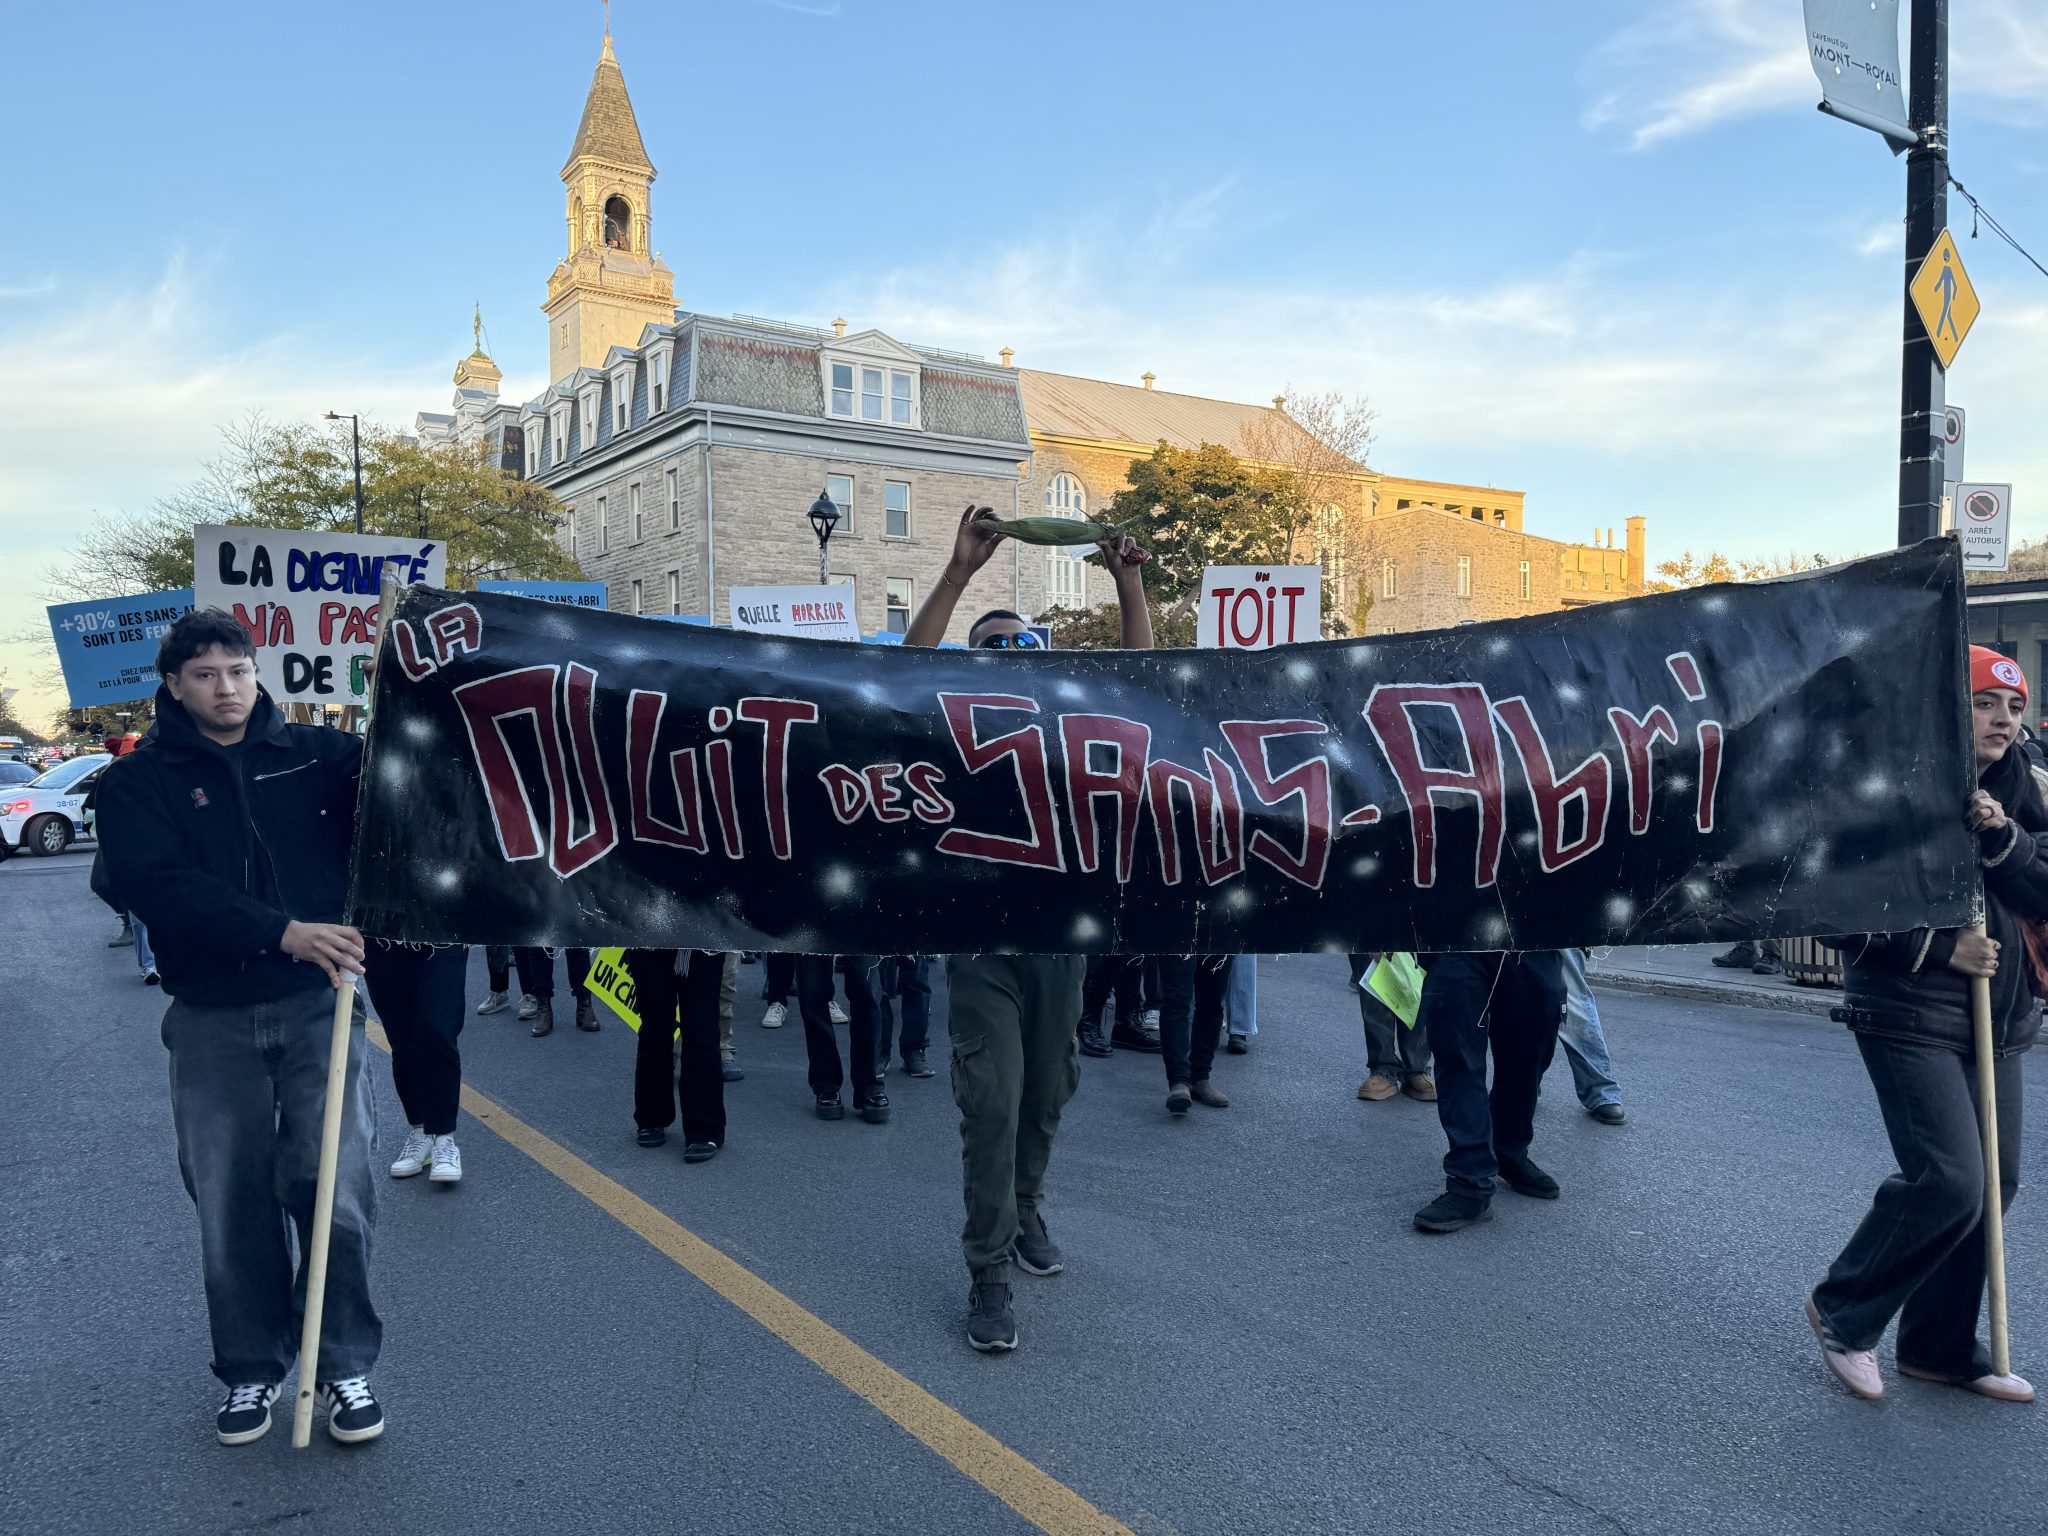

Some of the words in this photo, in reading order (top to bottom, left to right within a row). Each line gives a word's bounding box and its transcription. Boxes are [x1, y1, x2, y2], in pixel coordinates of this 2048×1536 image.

[1964, 536, 2002, 544] 'AUTOBUS
[218, 541, 274, 587] LA
[287, 543, 436, 596] DIGNITÉ
[60, 610, 116, 632] +30%
[117, 612, 143, 627] DES
[232, 602, 294, 648] N'A
[737, 604, 782, 625] QUELLE
[791, 602, 846, 622] HORREUR
[82, 631, 116, 648] SONT
[119, 628, 144, 643] DES
[393, 602, 483, 683] LA
[98, 679, 111, 689] EST
[113, 676, 122, 687] LÀ
[122, 675, 141, 685] POUR
[120, 667, 139, 677] CHEZ
[139, 665, 155, 674] DORI
[283, 653, 335, 695] DE
[818, 762, 955, 824] DES
[593, 960, 619, 993] UN
